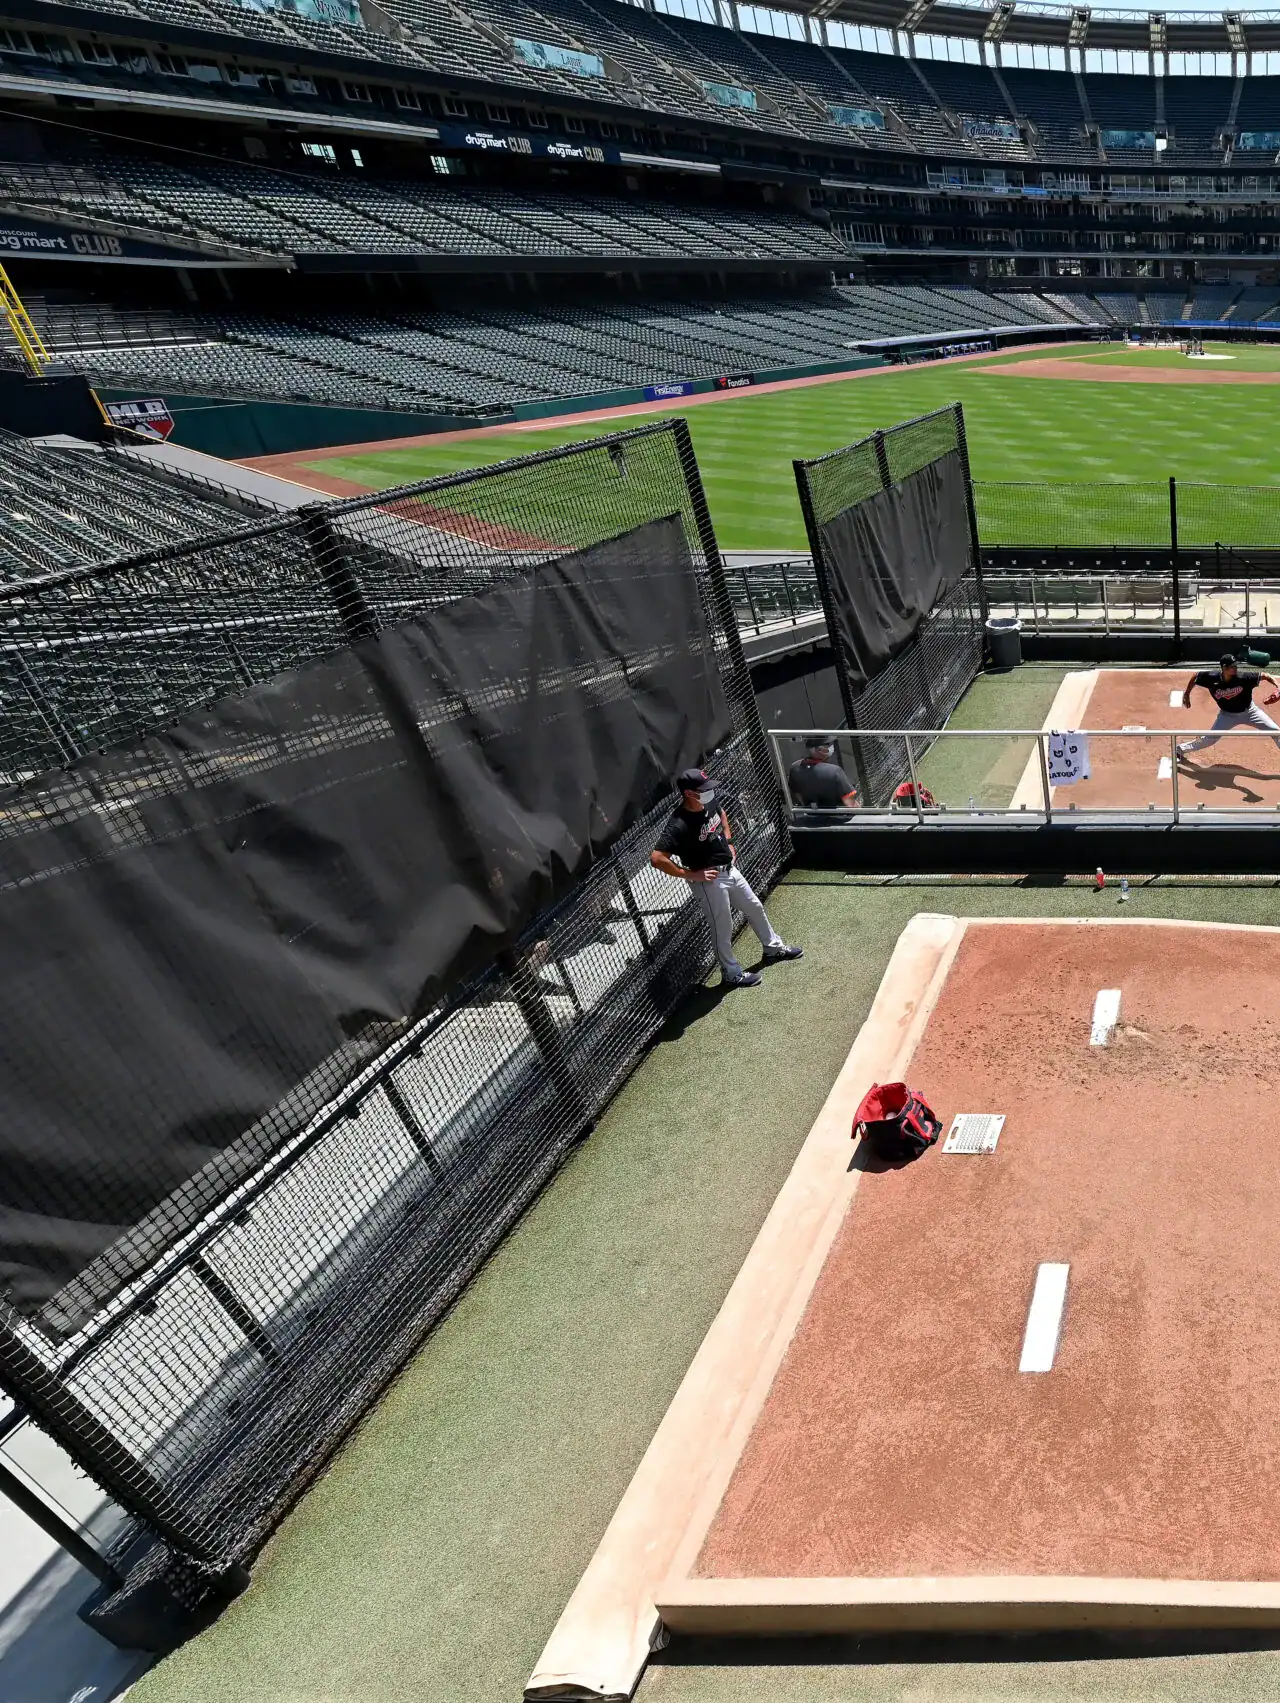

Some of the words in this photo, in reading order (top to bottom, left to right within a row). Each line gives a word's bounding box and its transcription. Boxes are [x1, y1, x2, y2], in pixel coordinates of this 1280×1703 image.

[465, 133, 487, 149] drug
[486, 138, 508, 149] mart
[507, 136, 533, 154] CLUB
[547, 144, 566, 158] drug
[565, 148, 584, 158] mart
[583, 146, 605, 162] CLUB
[22, 237, 68, 249] mart
[70, 233, 123, 256] CLUB
[727, 378, 750, 388] Fanatics
[107, 401, 166, 419] MLB
